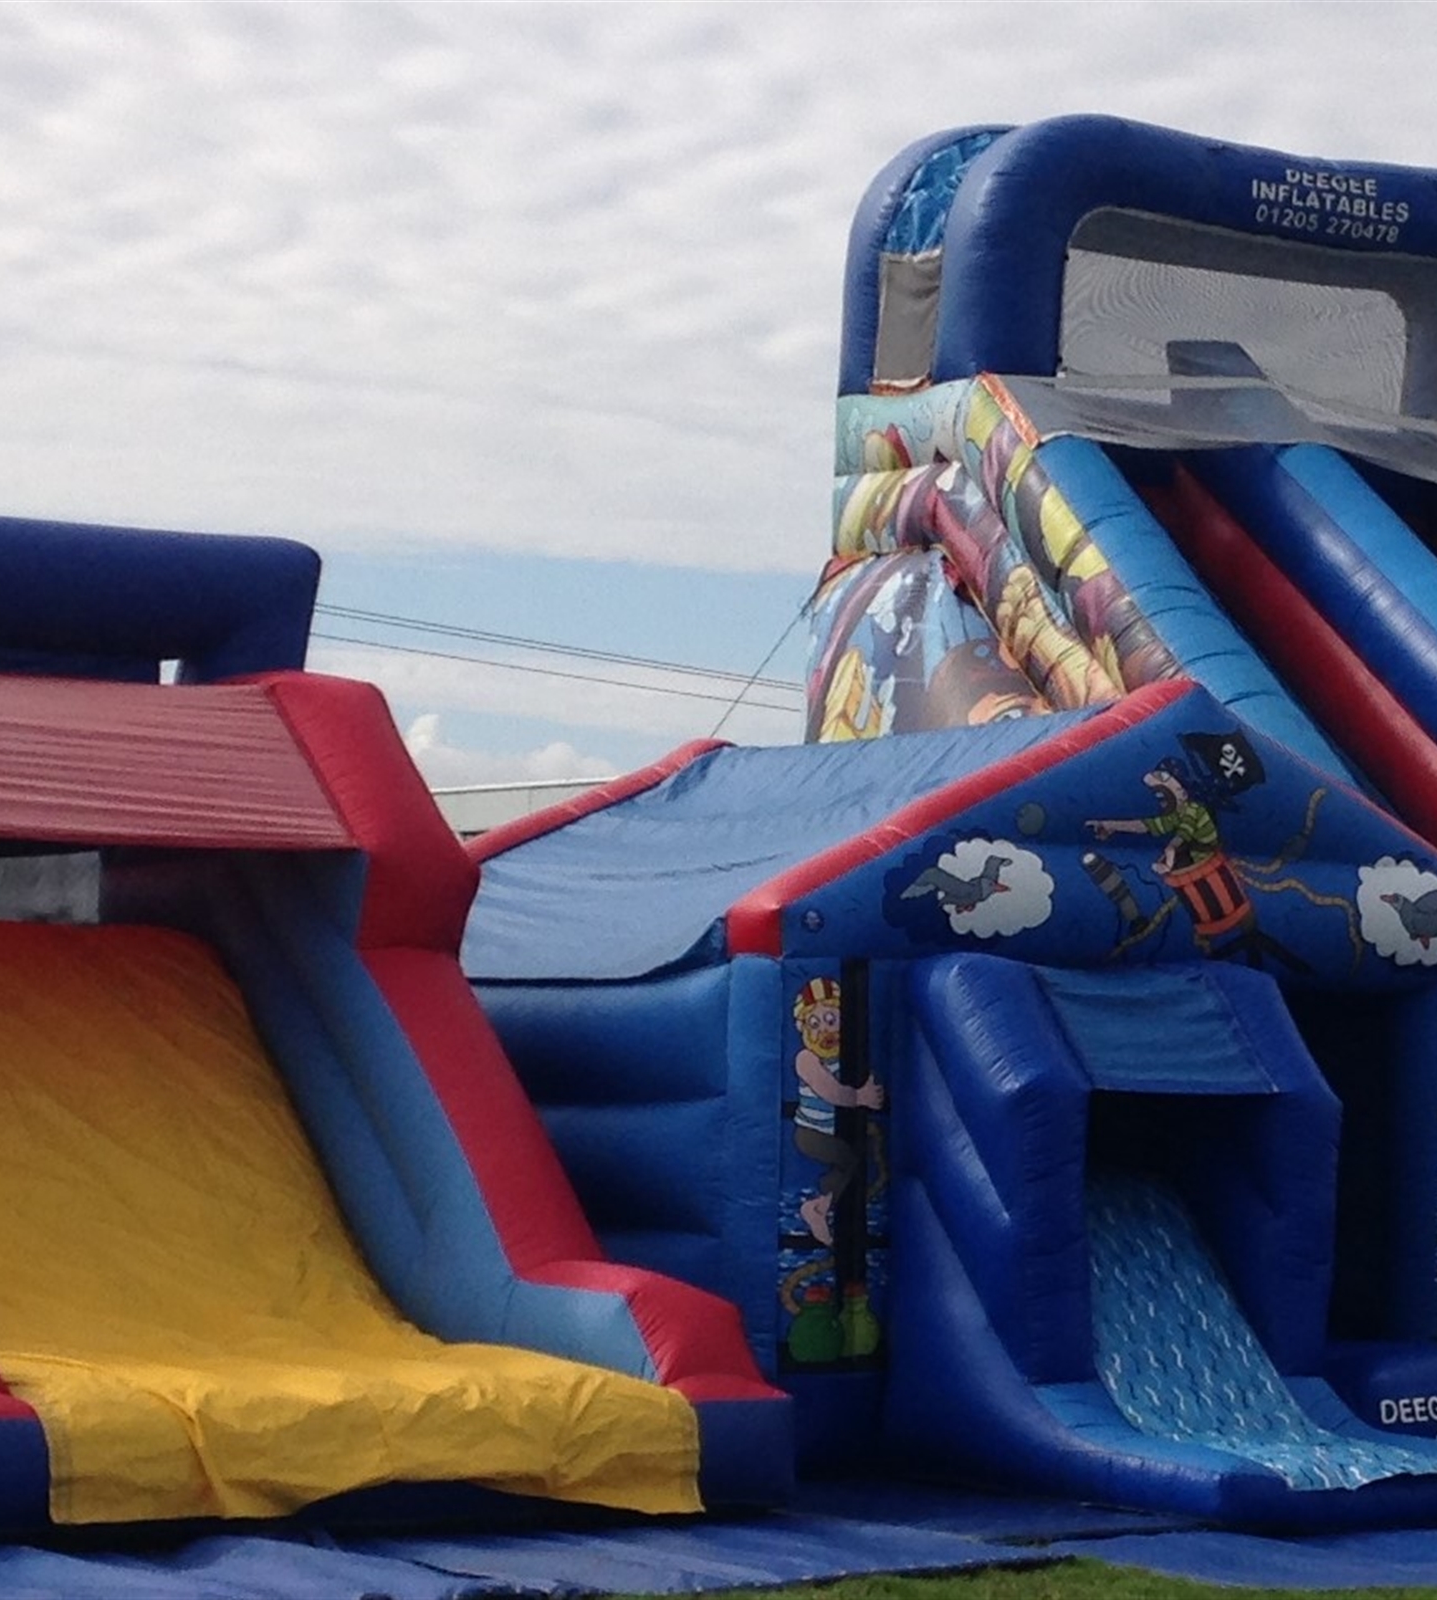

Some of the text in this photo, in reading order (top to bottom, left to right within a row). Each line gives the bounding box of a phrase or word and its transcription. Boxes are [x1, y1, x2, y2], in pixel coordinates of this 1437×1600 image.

[1252, 179, 1409, 222] INFLATABLES
[1286, 169, 1377, 197] DEEGEE
[1255, 204, 1399, 243] 01205 270478
